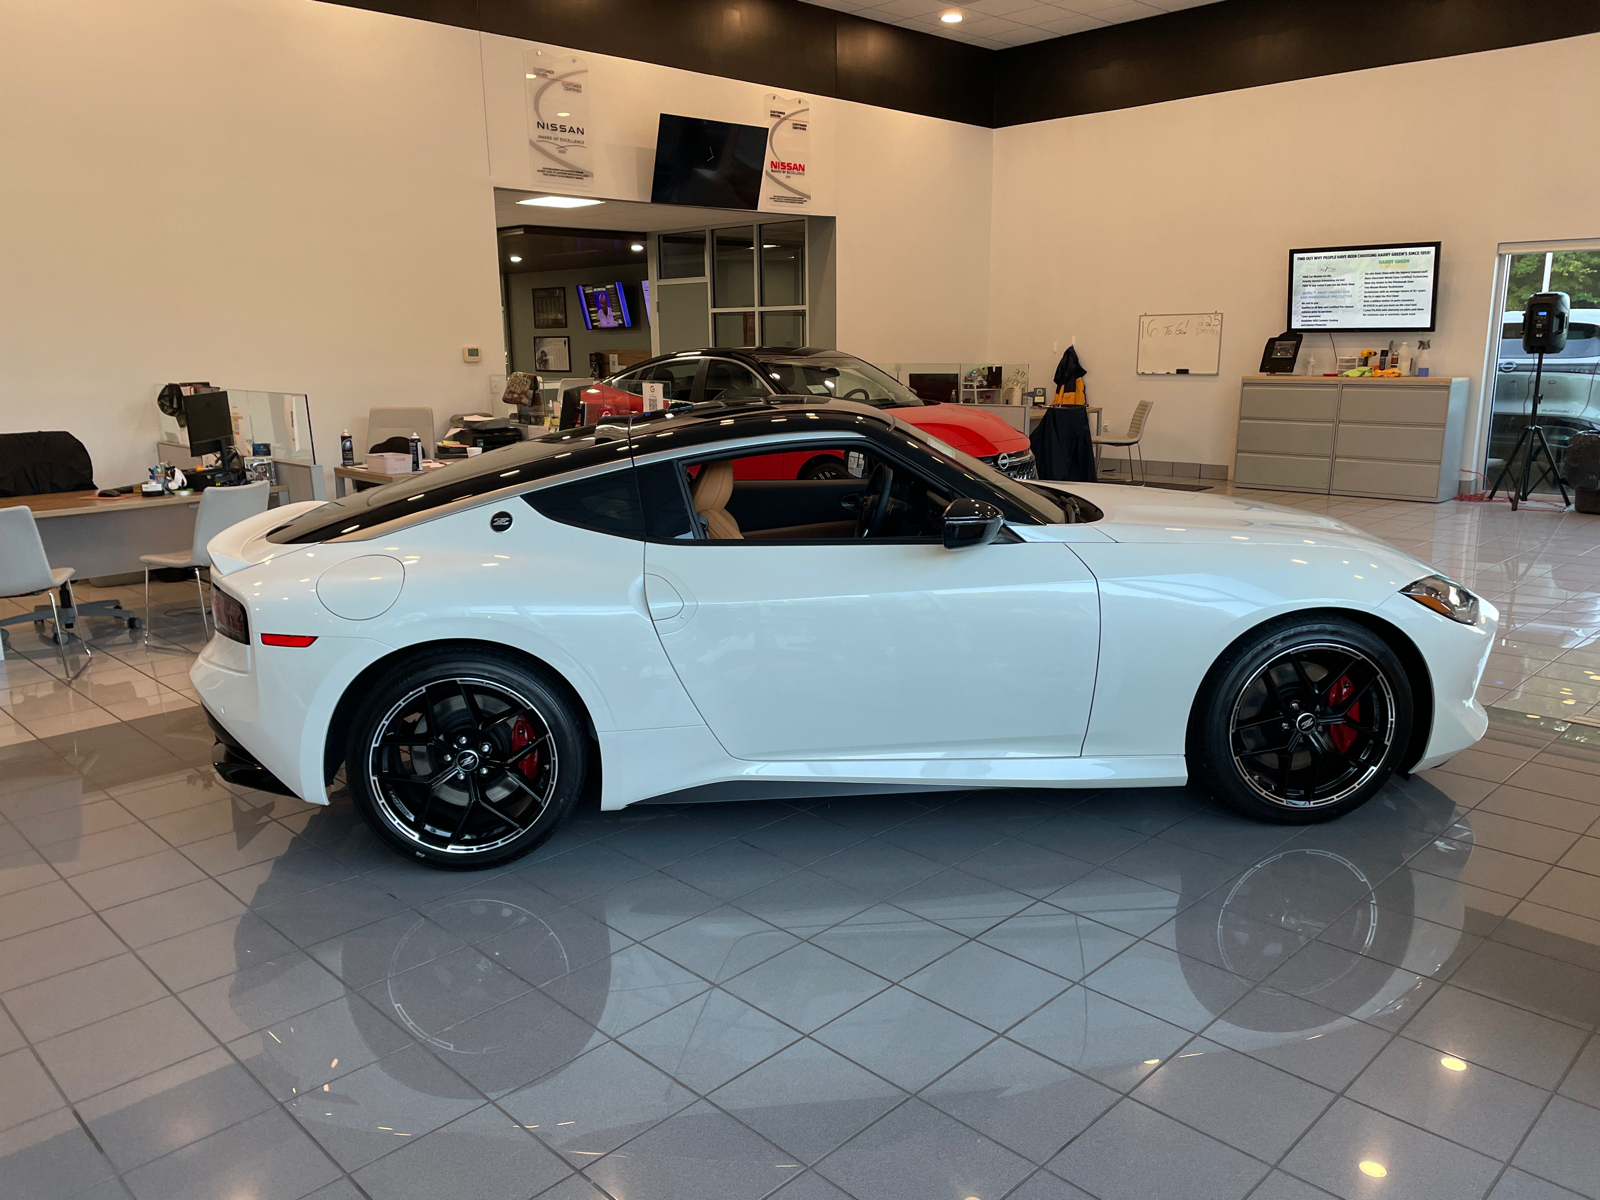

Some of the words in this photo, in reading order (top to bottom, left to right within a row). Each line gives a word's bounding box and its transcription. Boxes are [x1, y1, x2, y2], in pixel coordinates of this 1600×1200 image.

[536, 121, 584, 135] NISSAN
[770, 161, 805, 172] NISSAN
[1198, 315, 1220, 326] 225
[1164, 325, 1174, 336] To
